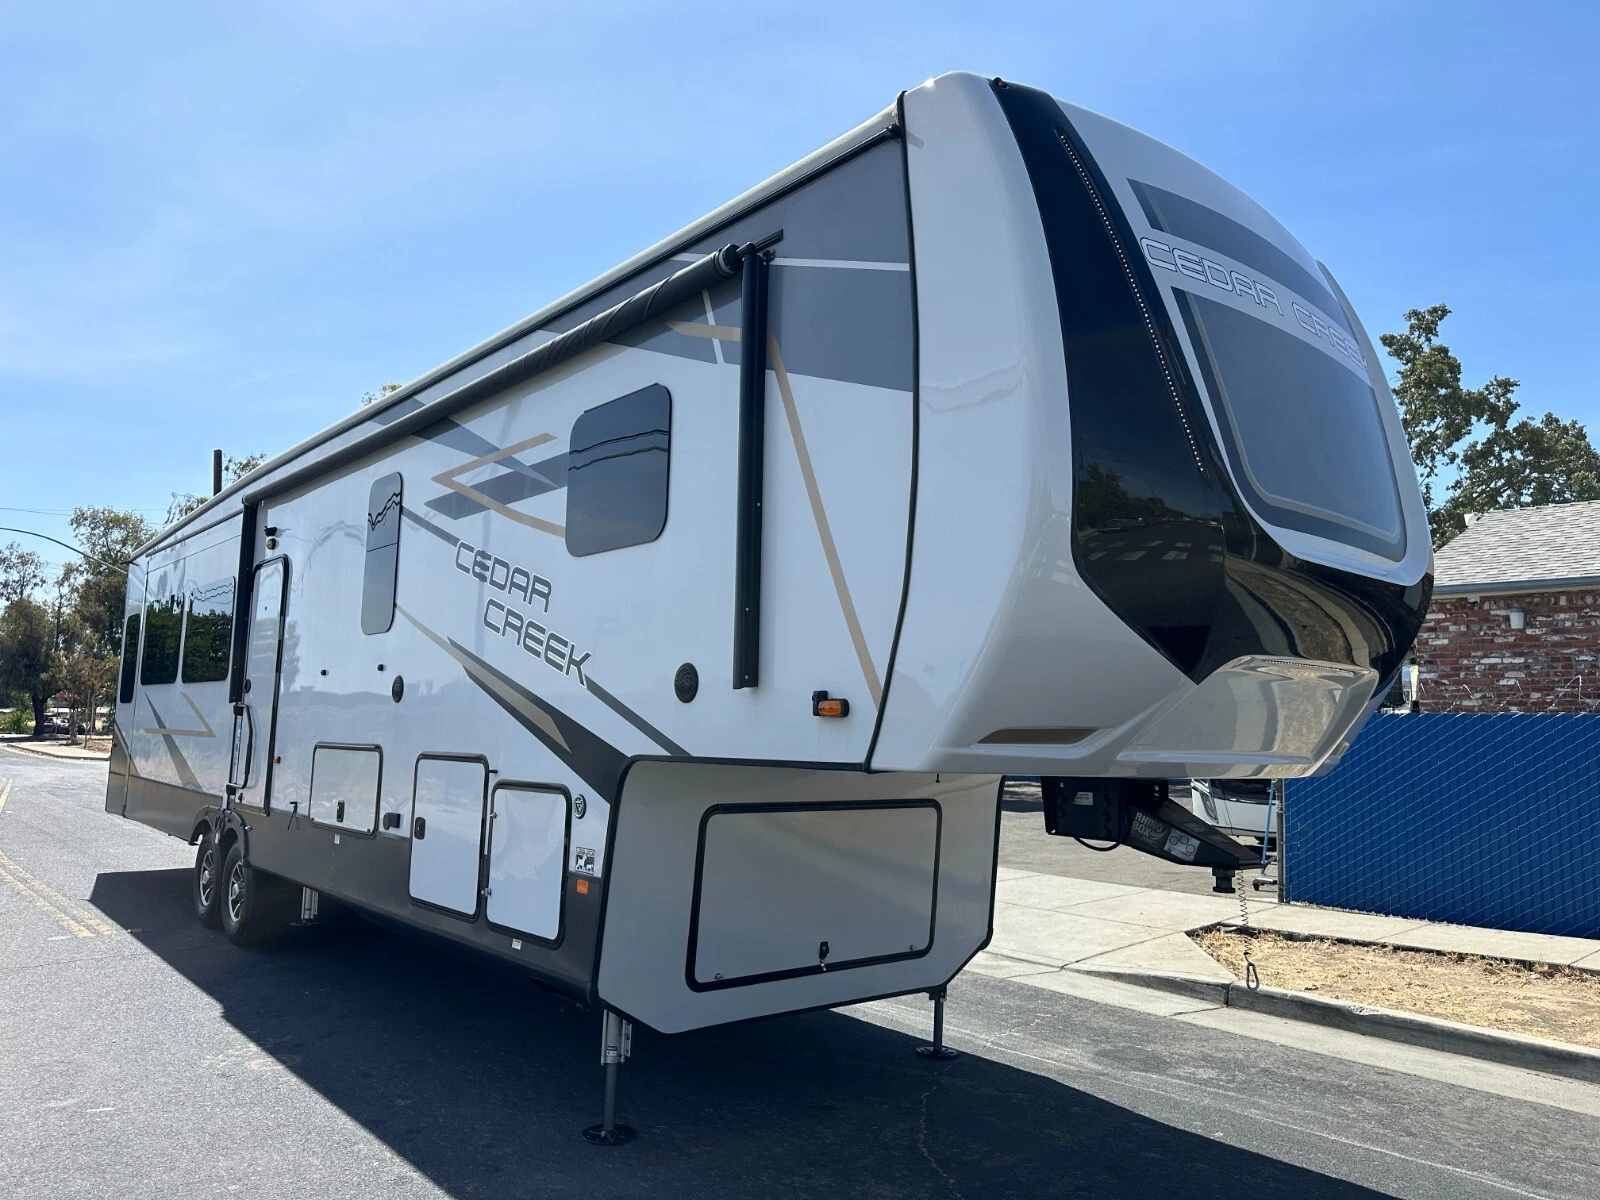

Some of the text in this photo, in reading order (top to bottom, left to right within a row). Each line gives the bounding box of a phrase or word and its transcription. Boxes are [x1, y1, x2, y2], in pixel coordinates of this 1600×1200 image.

[1140, 236, 1284, 317] CEDAR
[455, 540, 552, 614] CEDAR
[483, 597, 592, 689] CREEK
[1131, 820, 1152, 837] BOX
[1135, 811, 1164, 833] RHINO
